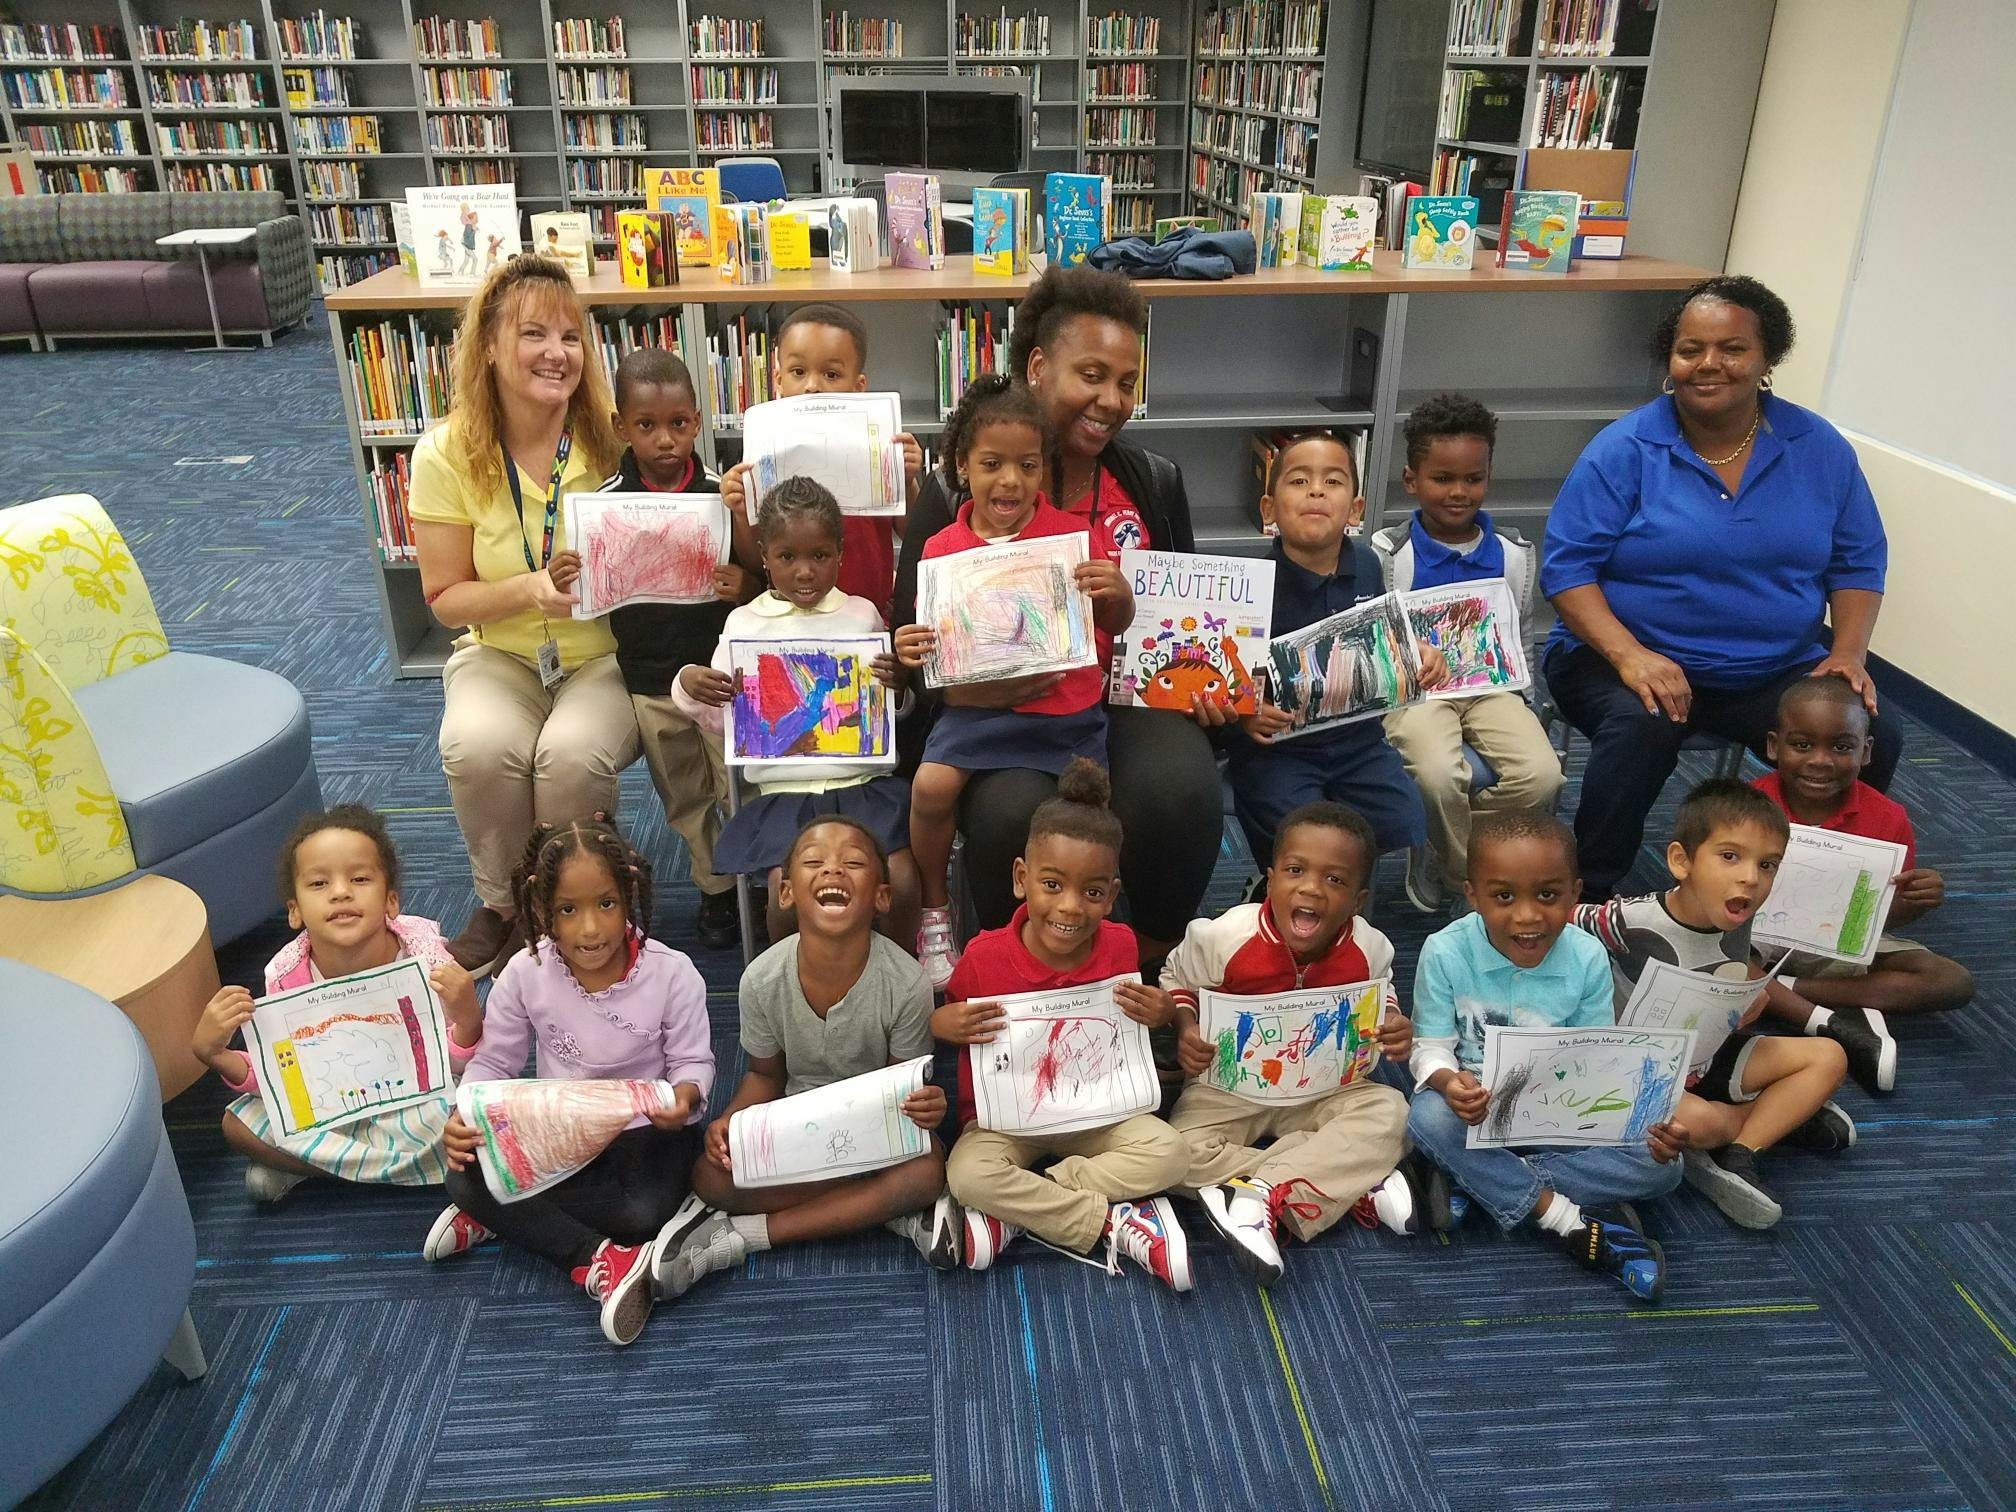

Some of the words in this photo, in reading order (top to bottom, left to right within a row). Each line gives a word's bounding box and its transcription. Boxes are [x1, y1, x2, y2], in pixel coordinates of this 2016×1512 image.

[660, 170, 705, 186] ABC
[422, 191, 439, 201] We're
[440, 191, 460, 202] Going
[476, 191, 491, 200] Bear
[492, 191, 509, 200] Hunt
[665, 187, 687, 195] Like
[690, 186, 708, 195] Me!
[804, 404, 828, 412] Building
[828, 403, 846, 411] Mural
[622, 503, 633, 511] My
[634, 503, 657, 511] Building
[659, 503, 677, 511] Mural
[972, 557, 983, 566] My
[985, 553, 1009, 563] Building
[1009, 549, 1029, 559] Mural
[1148, 554, 1185, 571] Maybe
[1192, 558, 1246, 577] Something
[1134, 569, 1254, 604] BEAUTIFUL
[1796, 836, 1822, 848] Building
[1823, 842, 1844, 851] Mural
[307, 997, 319, 1005] My
[321, 991, 346, 1001] Building
[346, 985, 368, 995] Mural
[1709, 986, 1721, 995] My
[1031, 1004, 1043, 1014] My
[1045, 1001, 1071, 1012] Building
[1071, 998, 1091, 1008] Mural
[1277, 1002, 1304, 1010] Building
[1558, 1039, 1571, 1047] My
[1572, 1037, 1600, 1046] Building
[1601, 1036, 1624, 1044] Mural
[1588, 1221, 1599, 1260] BATMAN
